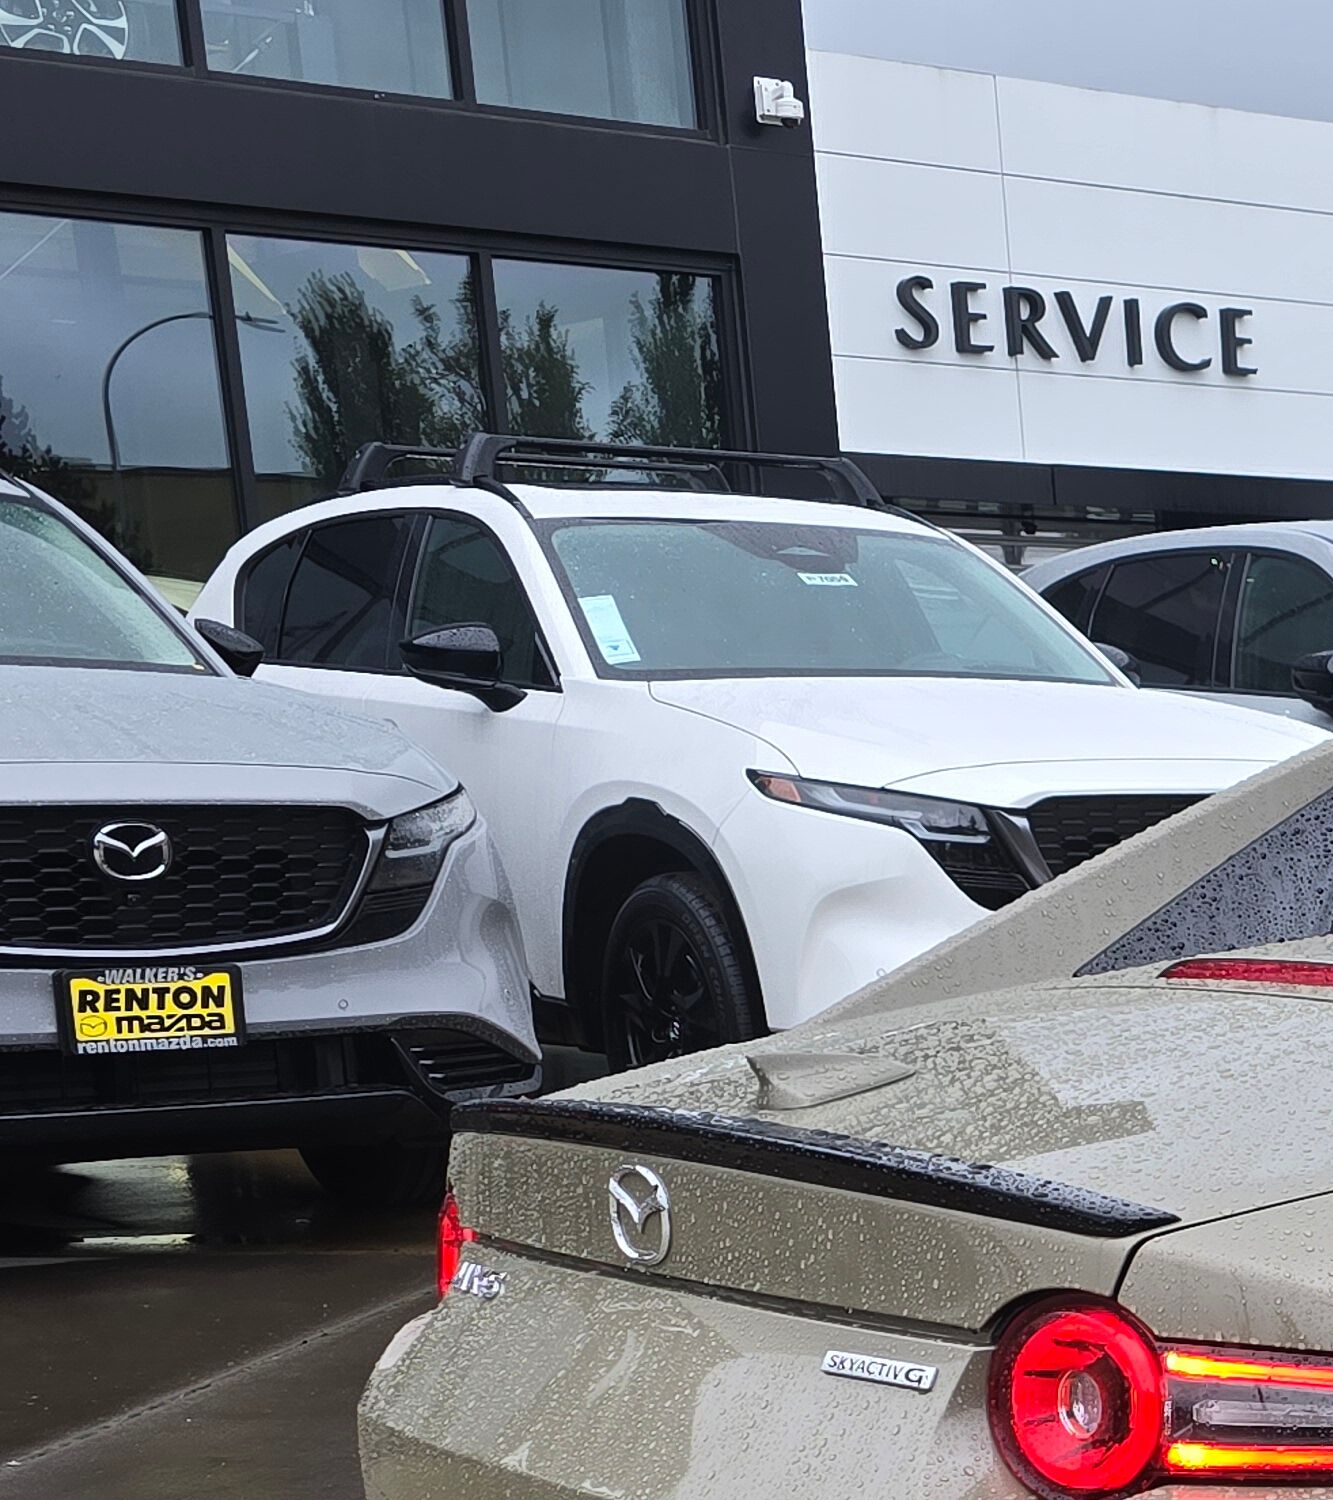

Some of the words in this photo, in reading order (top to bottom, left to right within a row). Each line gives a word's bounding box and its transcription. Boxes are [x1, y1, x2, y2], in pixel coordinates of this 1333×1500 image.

[895, 275, 1258, 377] SERVICE
[104, 966, 197, 985] WALKER'S
[77, 985, 226, 1013] RENTON
[115, 1012, 226, 1034] mazda
[77, 1035, 238, 1055] rentonmazda.com
